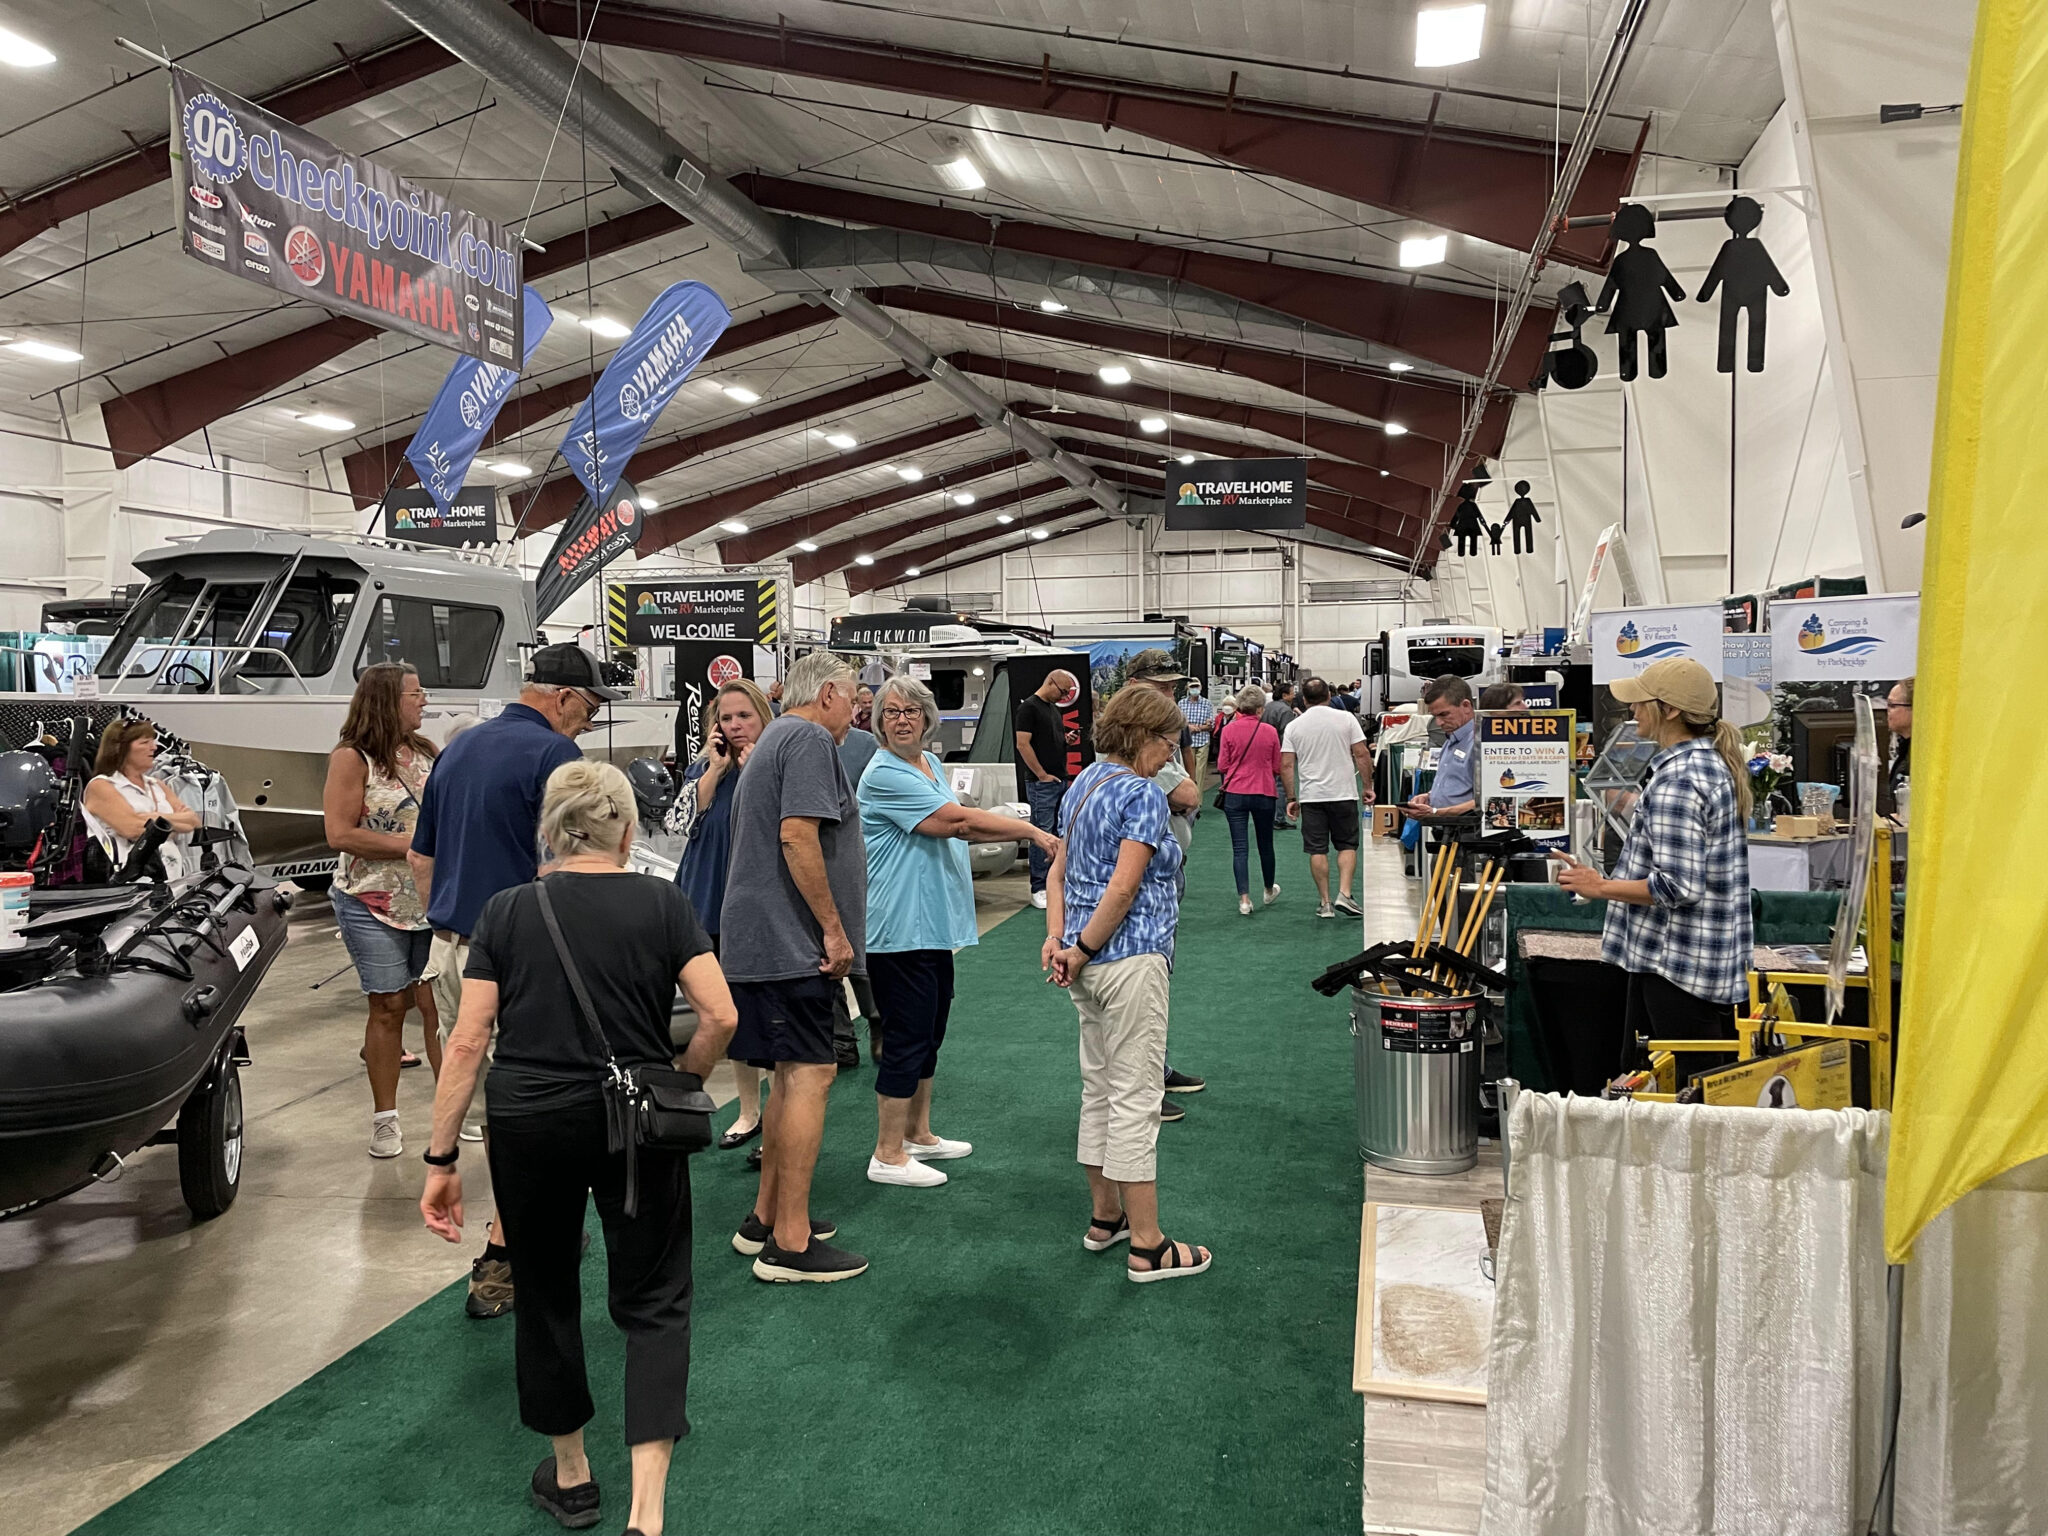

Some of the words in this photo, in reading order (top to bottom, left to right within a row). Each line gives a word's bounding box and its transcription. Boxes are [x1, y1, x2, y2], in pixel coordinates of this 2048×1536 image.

[249, 129, 517, 299] checkpoint.com
[245, 259, 270, 274] enzo
[327, 240, 460, 336] YAMAHA
[632, 313, 693, 400] YAMAHA
[470, 361, 505, 406] YAM
[1196, 480, 1293, 495] TRAVELHOME
[1204, 497, 1221, 506] The
[1222, 494, 1240, 505] RV
[1239, 496, 1293, 507] Marketplace
[409, 505, 486, 519] TRAVHOME
[416, 520, 430, 529] The
[430, 518, 444, 528] RV
[443, 520, 486, 529] Marketplace
[654, 589, 745, 604] TRAVELHOME
[662, 605, 678, 615] The
[679, 603, 695, 614] RV
[694, 604, 745, 616] Marketplace
[1642, 625, 1671, 634] Camping
[1828, 618, 1861, 627] Camping
[650, 623, 736, 640] WELCOME
[853, 629, 927, 644] ROCKWOO
[1644, 633, 1654, 641] RV
[1655, 631, 1677, 641] Resorts
[1842, 626, 1868, 635] Resorts
[1739, 650, 1751, 658] TV
[1817, 658, 1827, 667] by
[1491, 718, 1558, 735] ENTER
[1484, 747, 1516, 755] ENTER
[1519, 747, 1532, 755] TO
[1535, 747, 1555, 755] WIN
[1558, 747, 1565, 755] A
[272, 860, 339, 878] KARAVA
